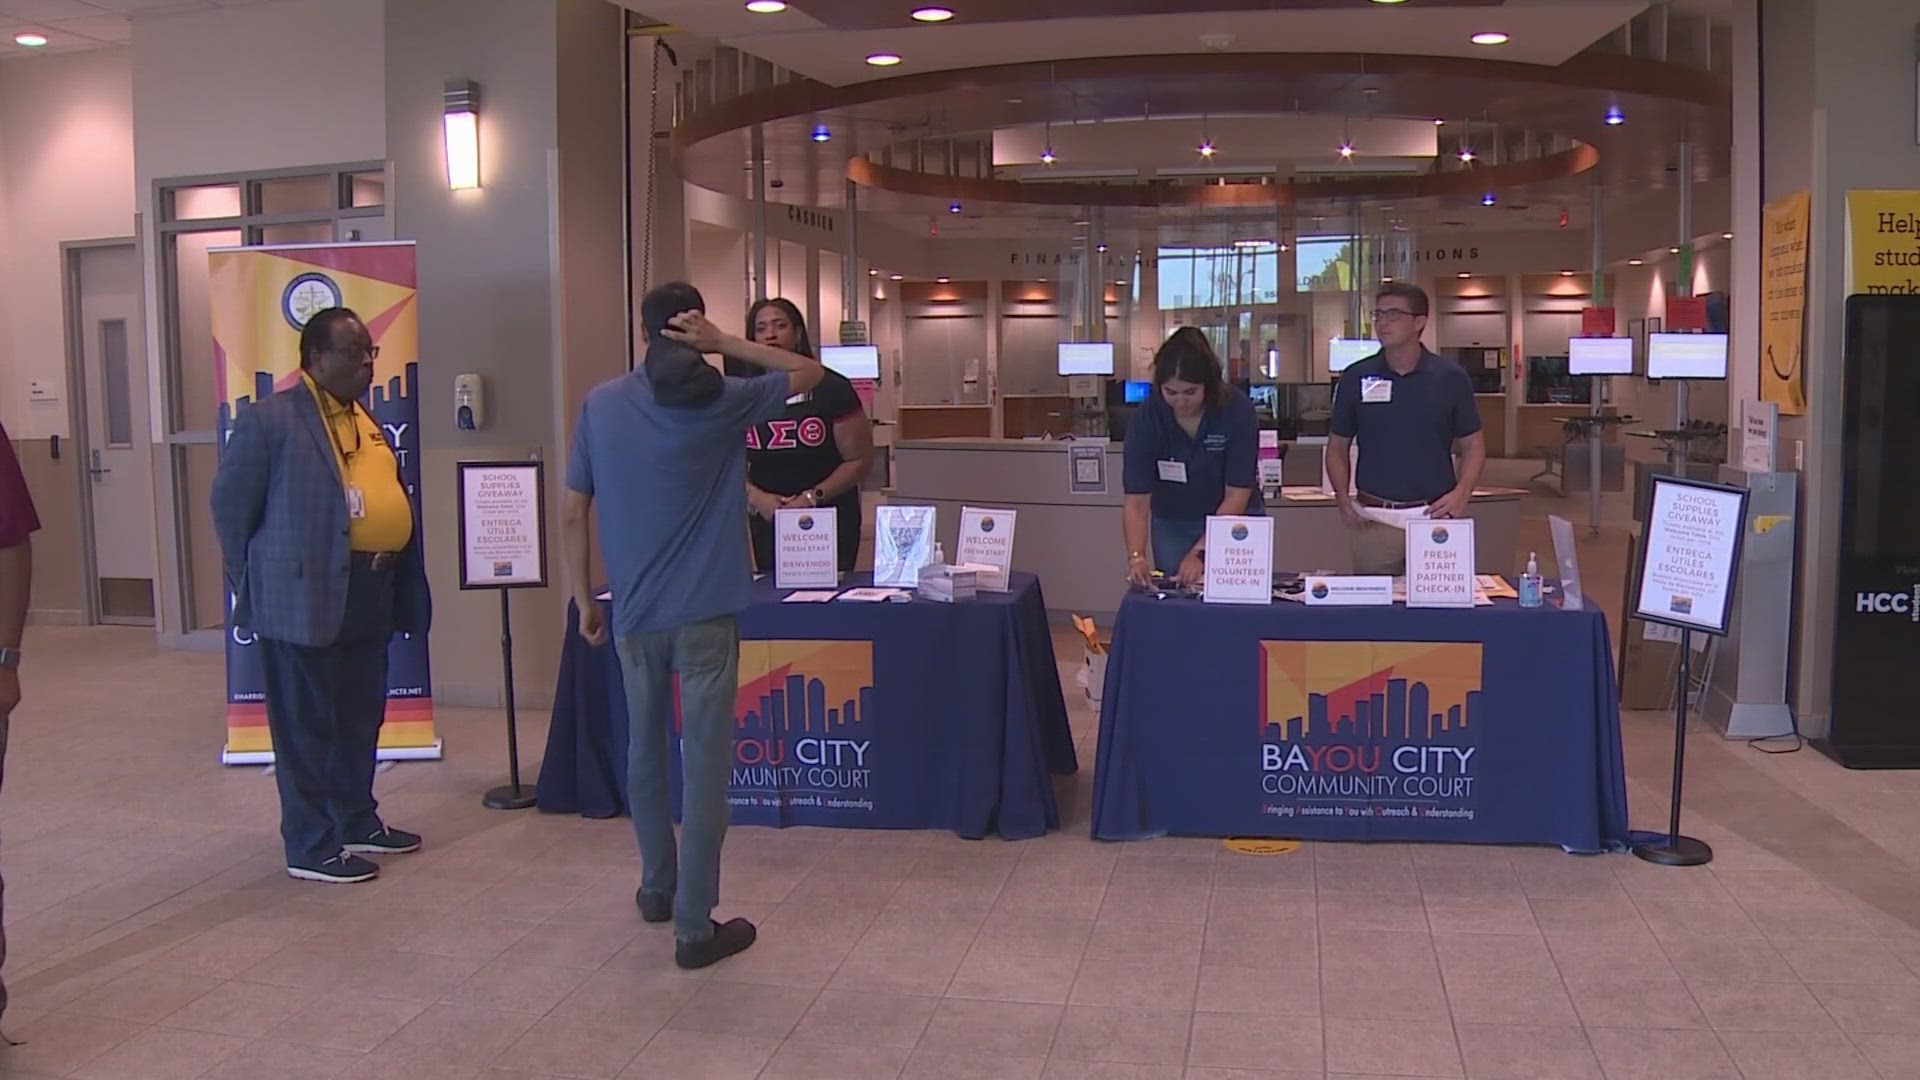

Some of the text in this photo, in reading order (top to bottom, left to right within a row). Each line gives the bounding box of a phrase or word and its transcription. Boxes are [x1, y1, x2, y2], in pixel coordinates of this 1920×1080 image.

[788, 203, 833, 231] CASHIER
[1010, 253, 1126, 266] FINANAL
[1875, 246, 1920, 266] stud
[482, 473, 517, 481] SCHOOL
[480, 482, 520, 490] SUPPLIES
[477, 490, 524, 498] GIVEAWAY
[1676, 493, 1717, 507] SCHOOL
[1672, 501, 1719, 518] SUPPLIES
[481, 519, 522, 528] ENTREGA
[1667, 511, 1721, 527] GIVEAWAY
[477, 535, 527, 544] ESCOLARES
[782, 533, 830, 542] WELCOME
[965, 535, 1007, 546] WELCOME
[808, 544, 830, 552] START
[1224, 547, 1254, 556] FRESH
[1666, 545, 1712, 560] ENTREGA
[1423, 550, 1457, 560] FRESH
[1224, 558, 1253, 566] START
[1424, 562, 1457, 570] START
[1211, 567, 1266, 576] VOLUNTEER
[1658, 563, 1715, 580] ESCOLARES
[1215, 577, 1260, 586] CHECK-IN
[1416, 573, 1465, 582] PARTNER
[1415, 584, 1466, 593] CHECK-IN
[1856, 592, 1909, 613] HCC
[795, 738, 871, 767] CITY
[1262, 744, 1475, 774] BAYOU CITY
[729, 767, 871, 788] MUNITY COURT
[1261, 774, 1474, 798] COMMUNITY COURT
[1263, 804, 1474, 821] Bringing Assistance to You with Outreach & Understanding
